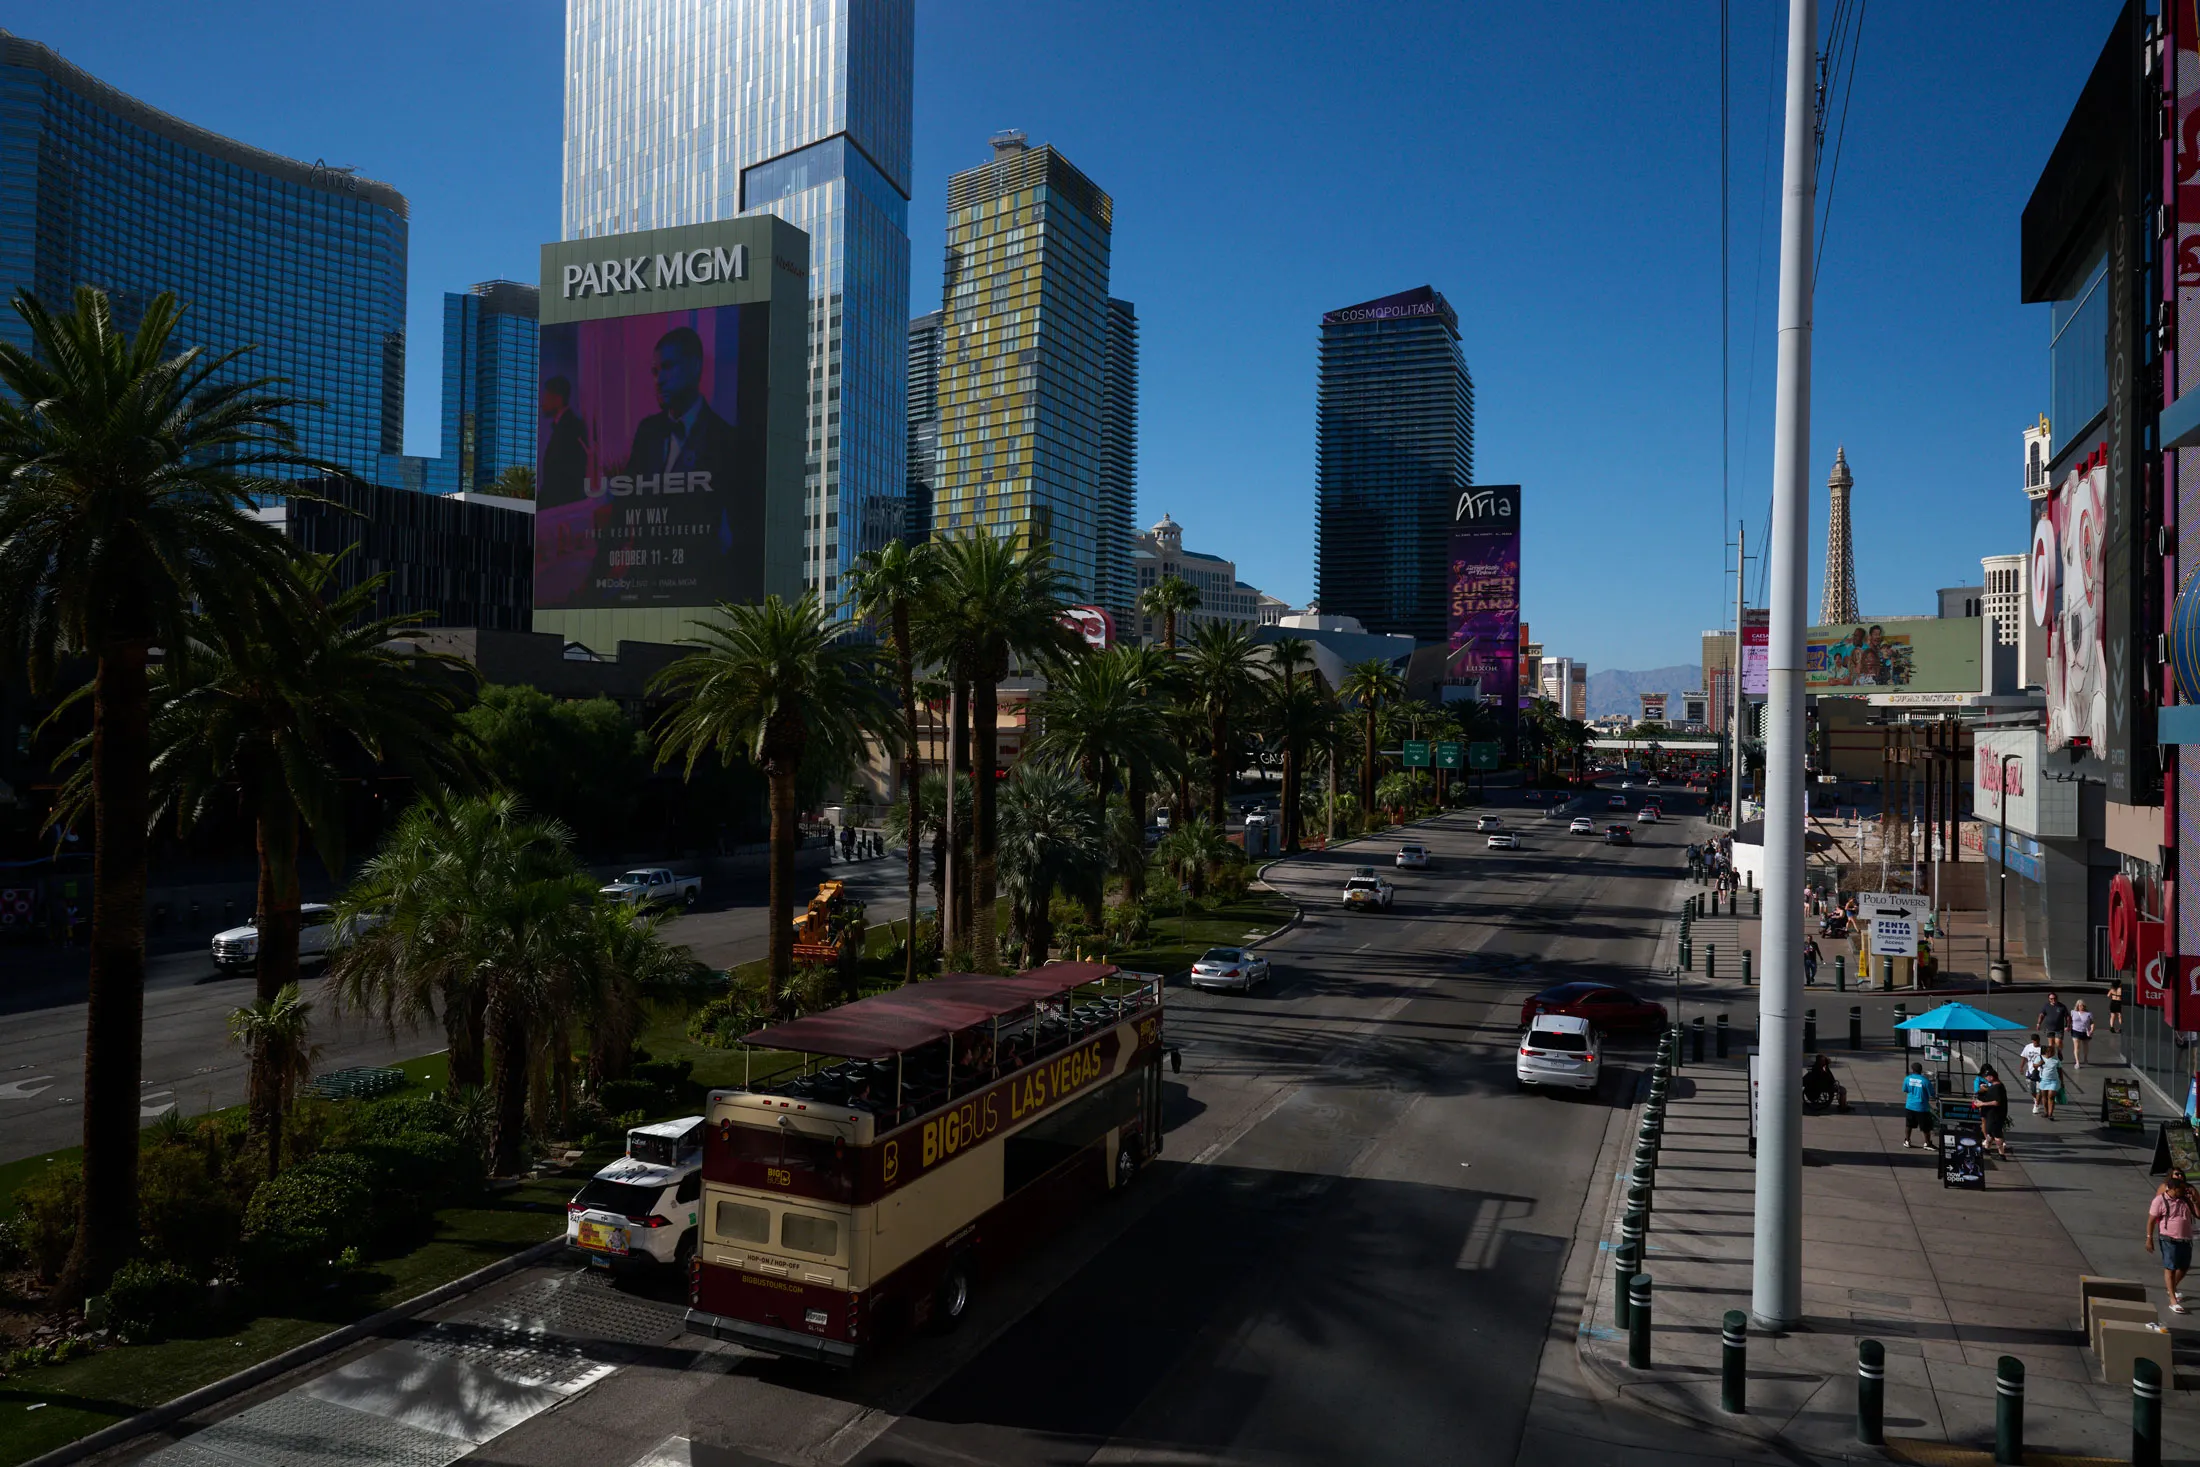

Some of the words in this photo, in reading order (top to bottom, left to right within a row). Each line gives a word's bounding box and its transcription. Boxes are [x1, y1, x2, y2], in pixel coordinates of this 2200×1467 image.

[563, 254, 648, 299] PARK
[654, 243, 745, 288] MGM
[1341, 303, 1434, 321] COSMOPOLITAN
[583, 471, 714, 498] USHER
[1456, 490, 1512, 521] Aria
[625, 508, 641, 525] MY
[646, 507, 669, 525] WAY
[585, 527, 603, 540] THE
[650, 523, 712, 537] RESIDENCY
[608, 549, 647, 567] OCTOBER
[650, 549, 661, 565] 11
[671, 548, 684, 564] 28
[606, 578, 631, 589] Dolby
[1878, 921, 1910, 930] PENTA
[1011, 1068, 1047, 1120] LAS
[1050, 1041, 1102, 1098] VEGAS
[767, 1168, 780, 1178] BIG
[747, 1254, 769, 1264] HOP-ON
[774, 1260, 800, 1270] HOP-OFF
[741, 1274, 804, 1295] BIGBUSTOURS.COM
